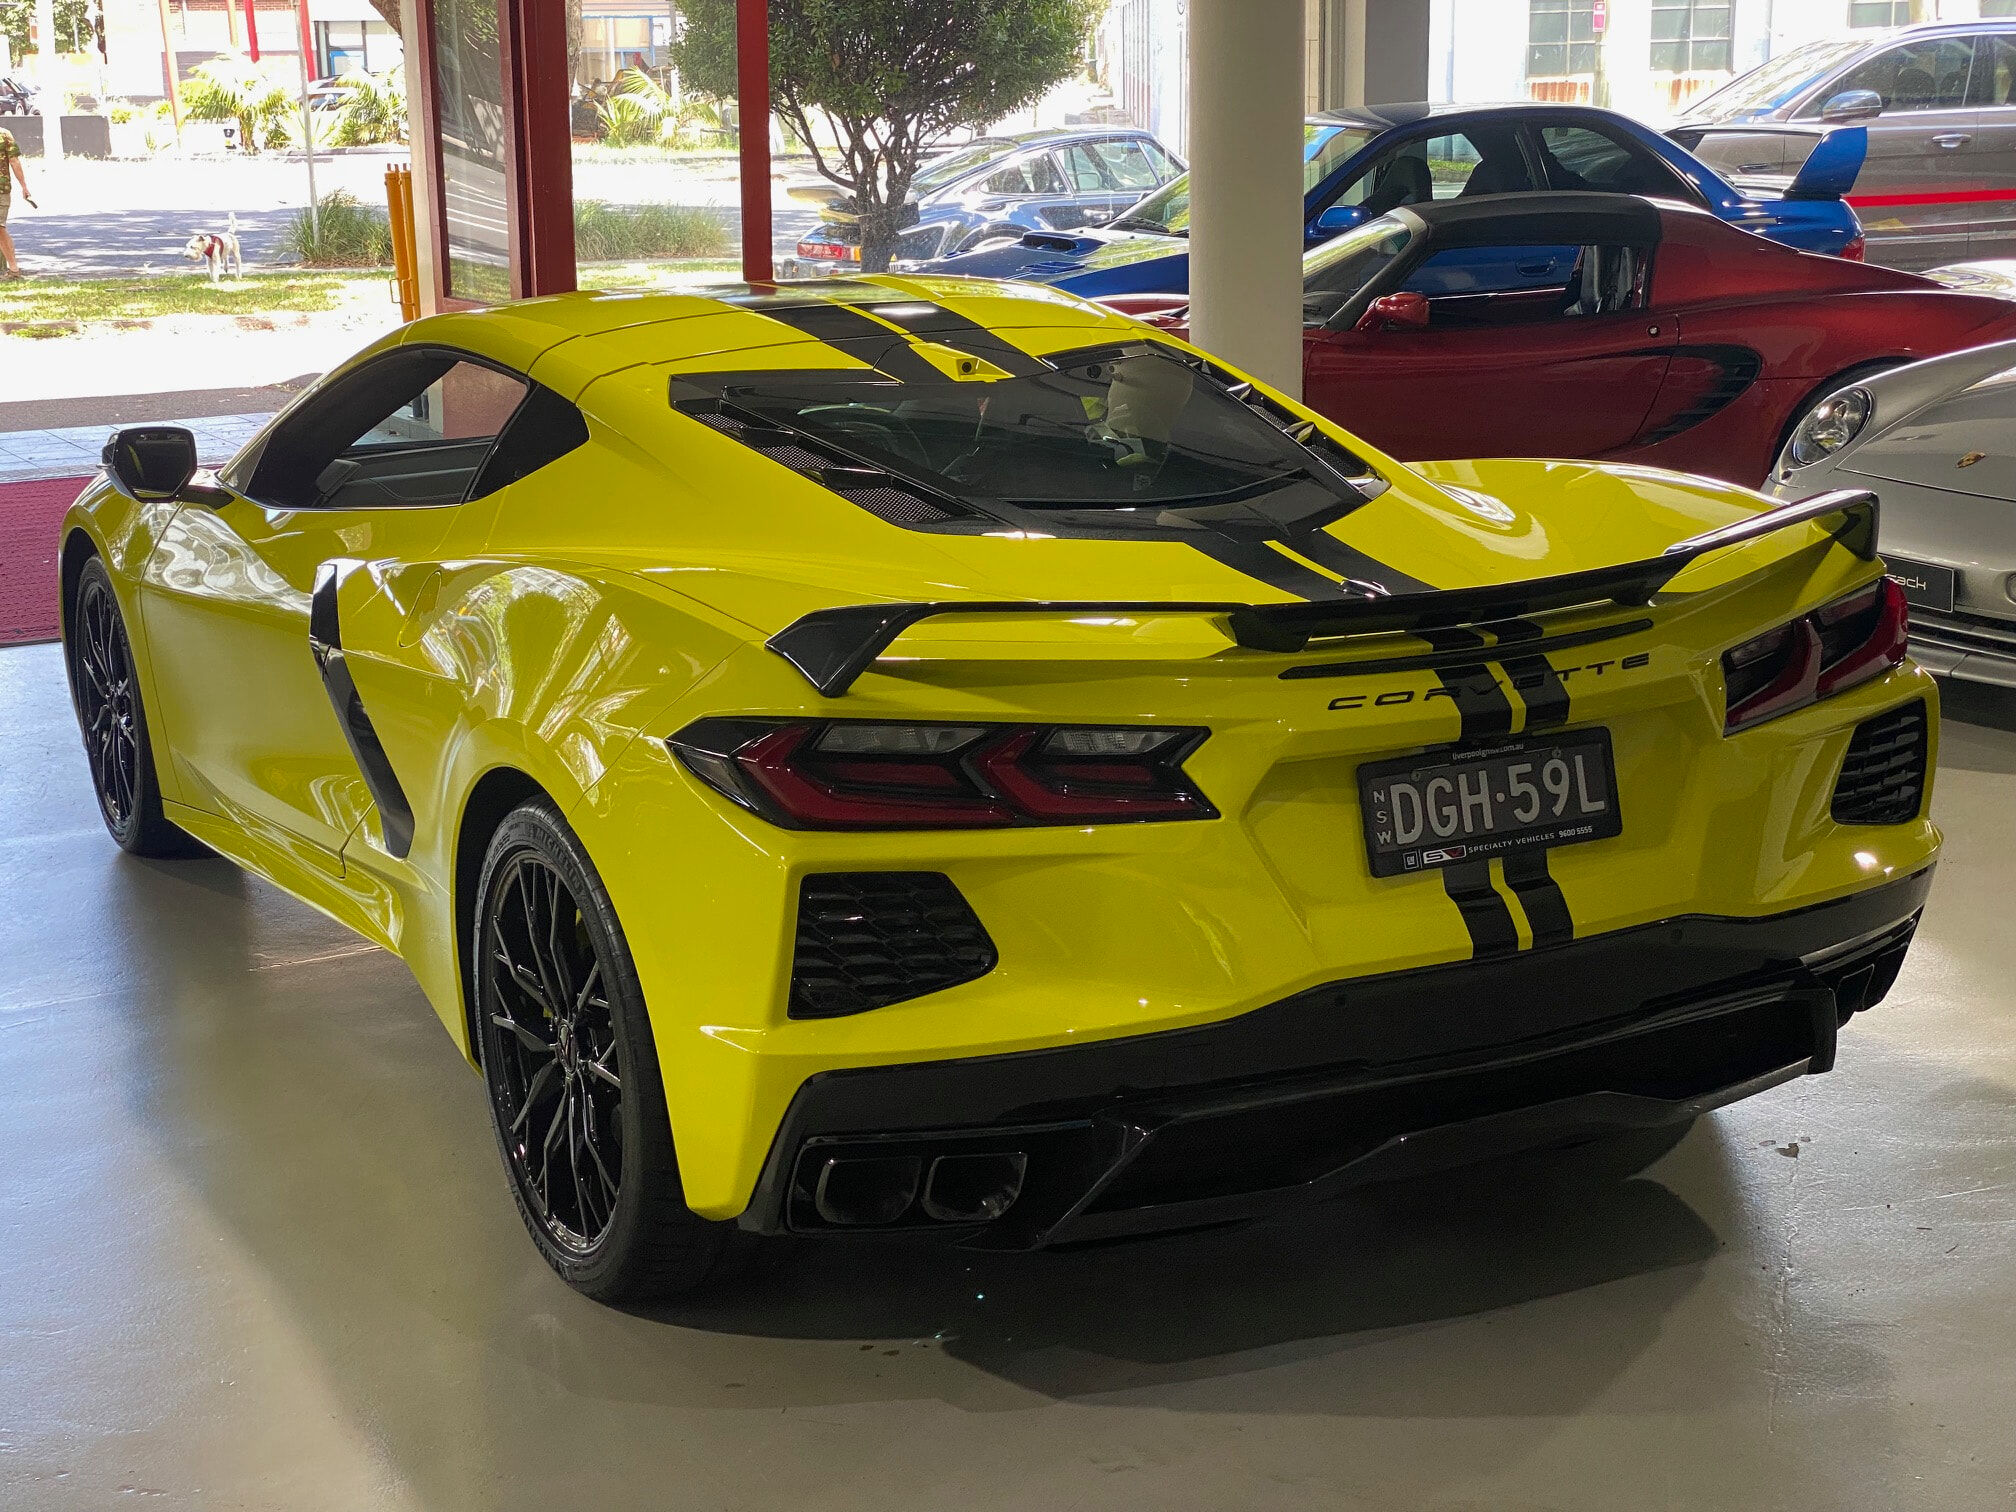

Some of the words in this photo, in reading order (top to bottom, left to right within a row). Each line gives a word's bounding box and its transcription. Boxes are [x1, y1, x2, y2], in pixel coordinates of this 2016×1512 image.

[1327, 652, 1650, 711] CORVETTE
[1468, 840, 1513, 853] SPECIALTY
[1516, 832, 1555, 845] VEHICLES
[1558, 828, 1576, 838] 9600
[1576, 825, 1593, 835] 5555
